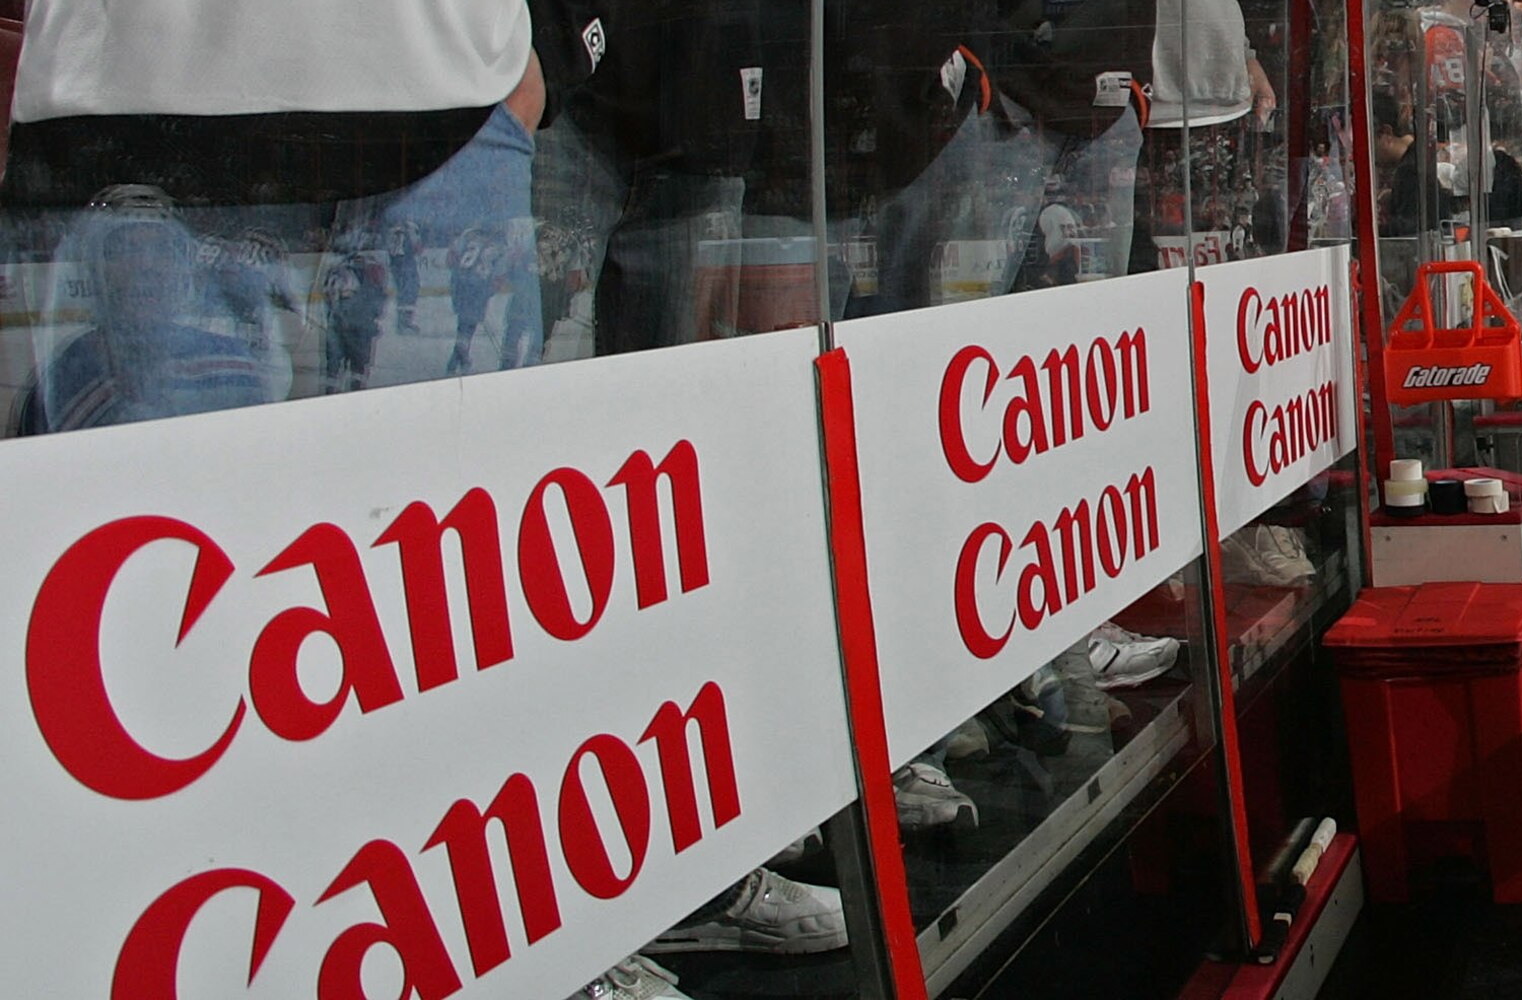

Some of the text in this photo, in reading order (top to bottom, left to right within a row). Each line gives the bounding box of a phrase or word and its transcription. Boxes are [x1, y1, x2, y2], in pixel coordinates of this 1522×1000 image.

[1237, 283, 1331, 375] Canon
[1403, 363, 1492, 388] Gatorade
[938, 326, 1151, 484] Canon
[1243, 380, 1336, 488] Canon
[25, 438, 711, 801] Canon
[954, 466, 1160, 660] Canon
